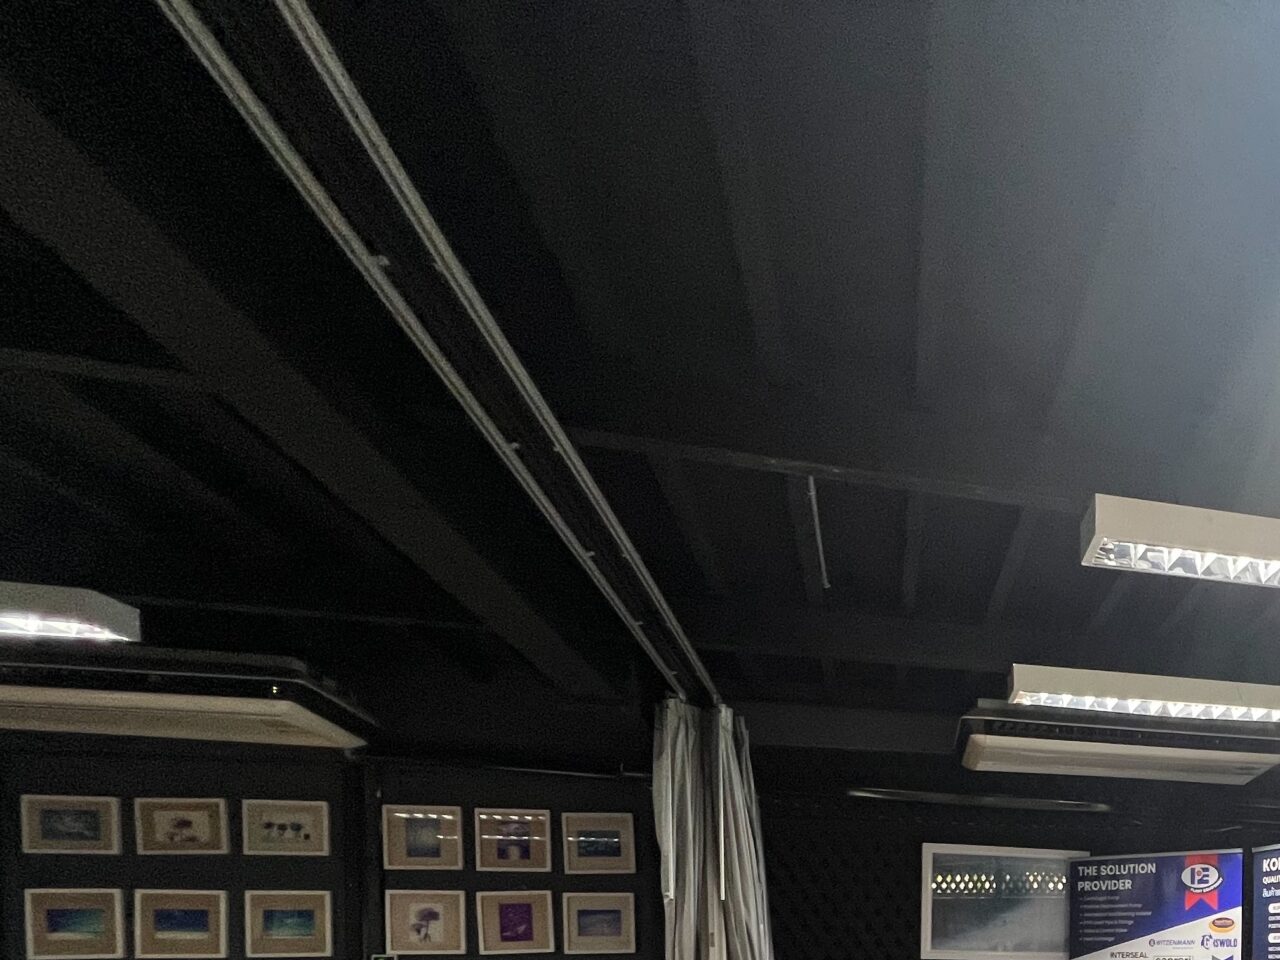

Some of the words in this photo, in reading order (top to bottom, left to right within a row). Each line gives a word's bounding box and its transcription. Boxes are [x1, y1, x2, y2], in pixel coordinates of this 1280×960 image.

[1078, 866, 1098, 876] THE
[1100, 863, 1156, 876] SOLUTION
[1078, 880, 1132, 891] PROVIDER
